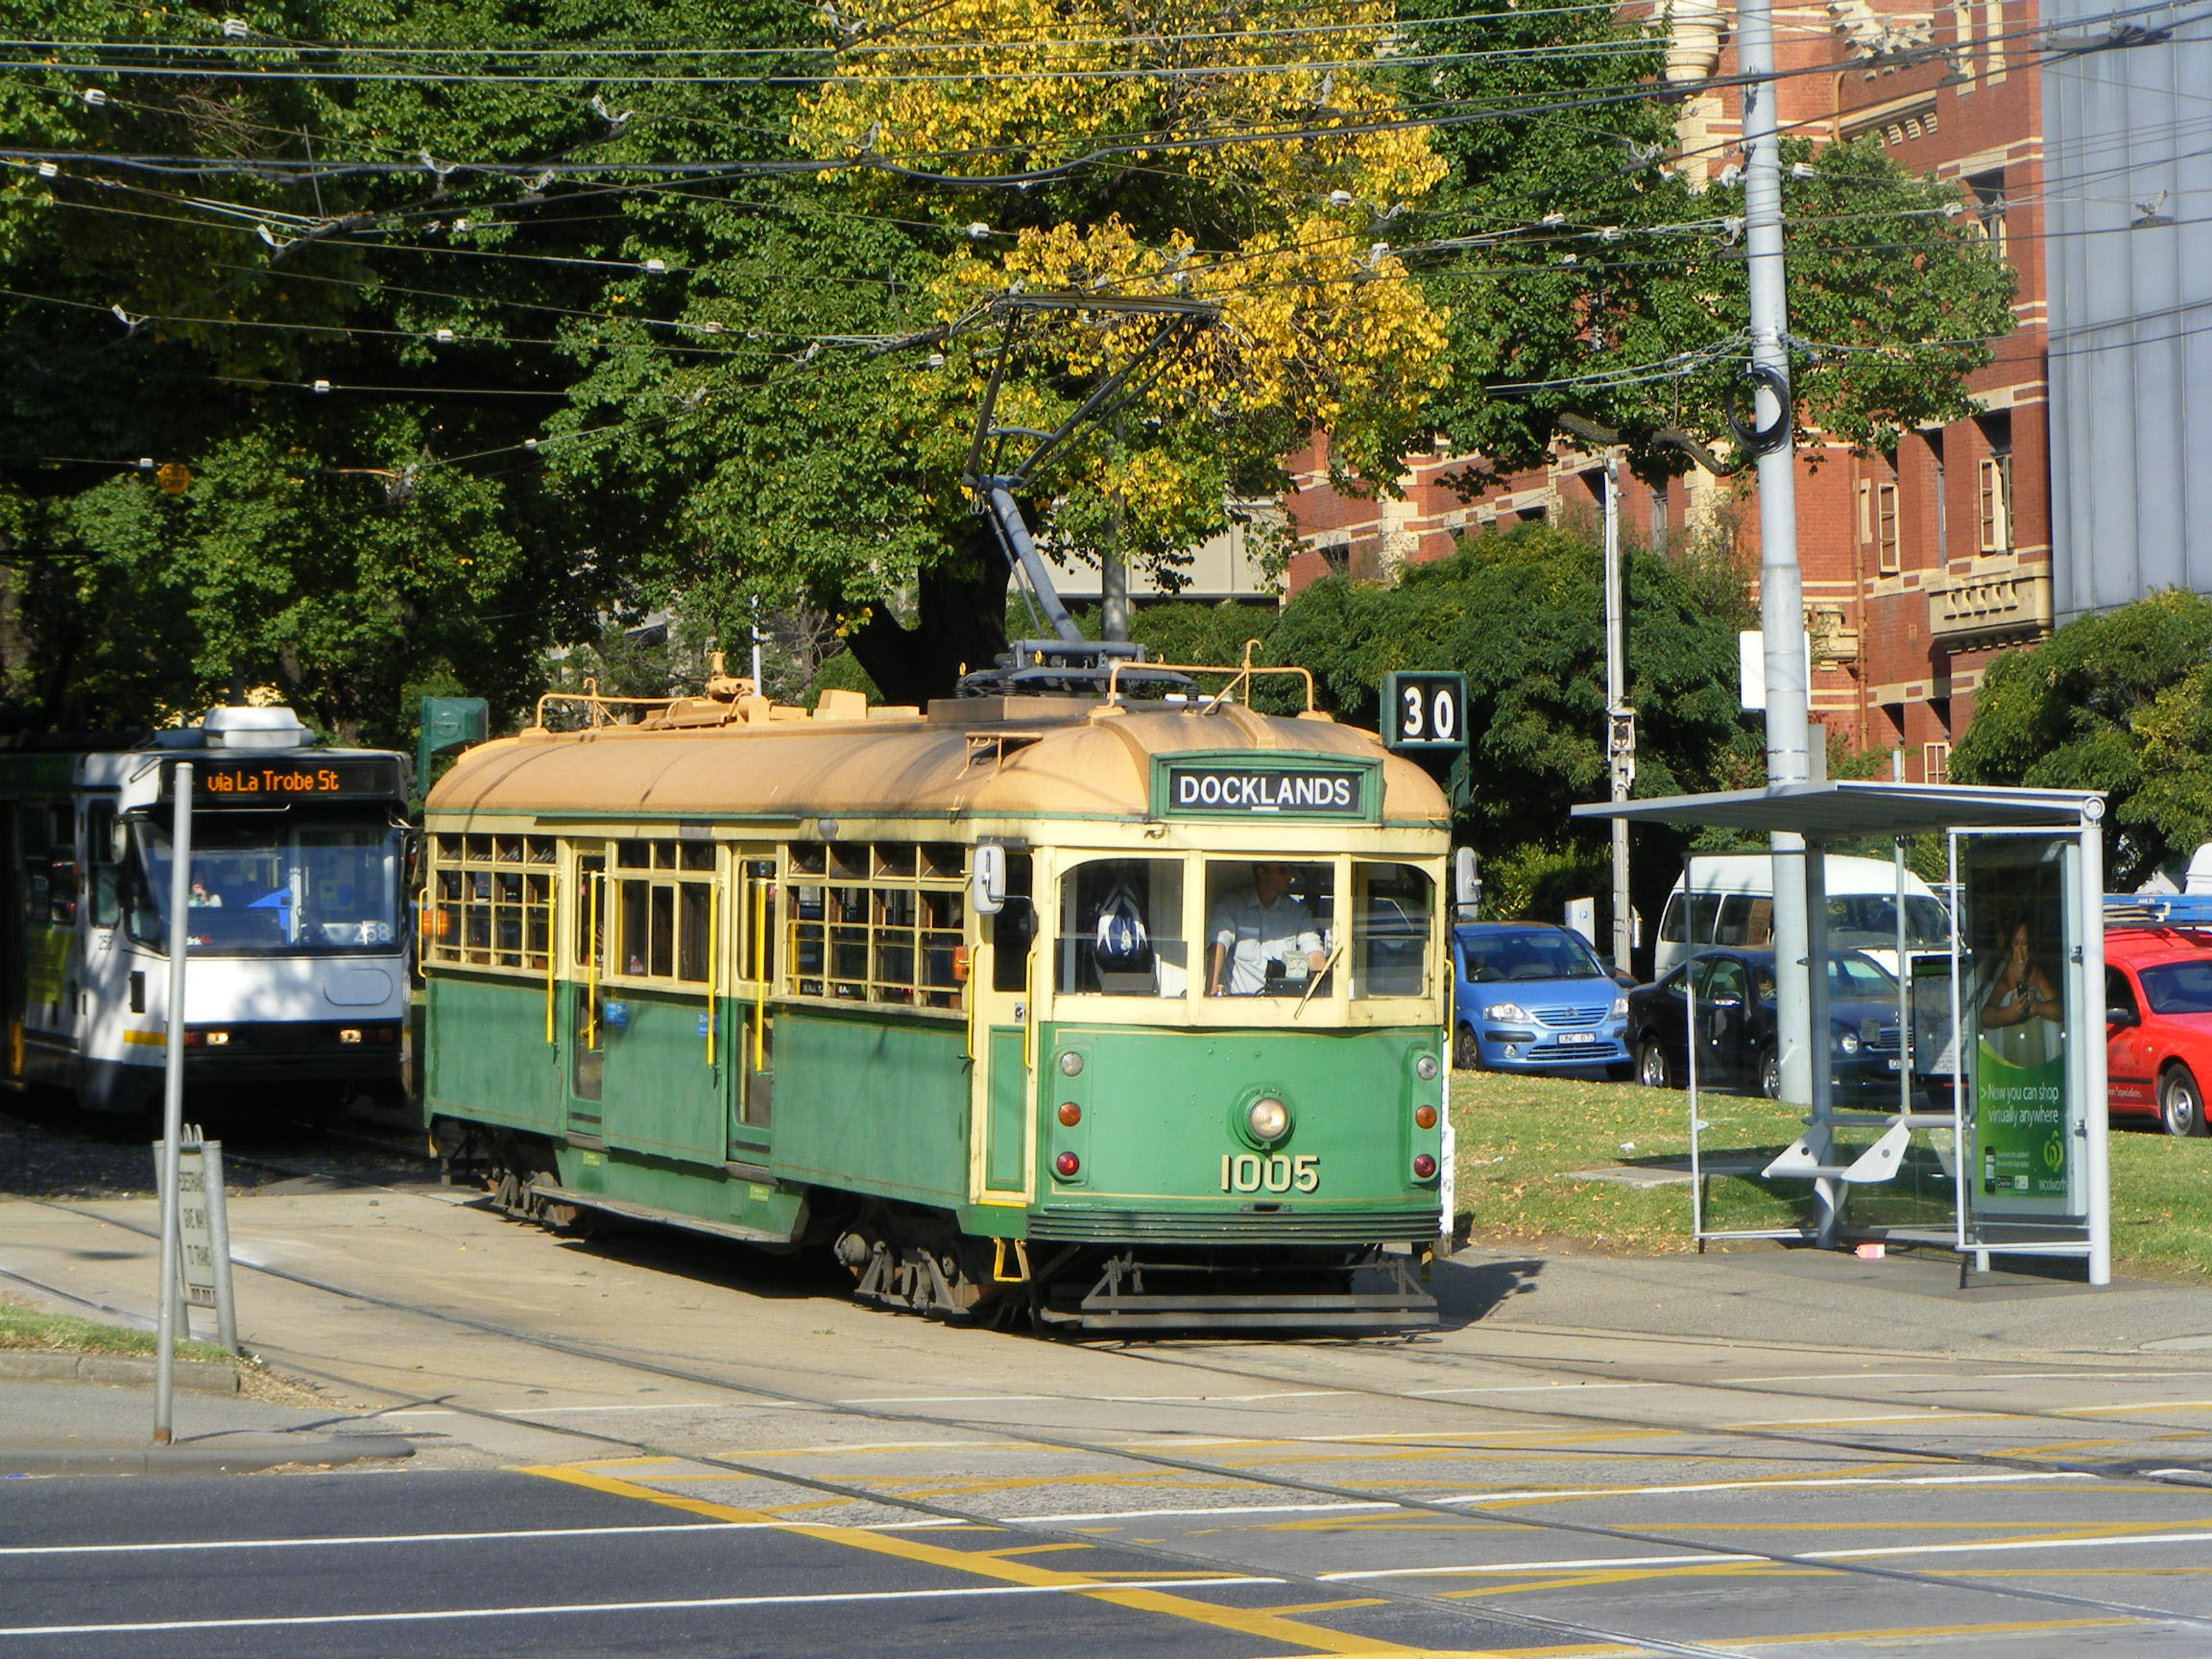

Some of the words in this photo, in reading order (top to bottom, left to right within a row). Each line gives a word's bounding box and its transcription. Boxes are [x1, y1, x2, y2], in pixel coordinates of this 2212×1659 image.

[1404, 685, 1455, 738] 30
[207, 772, 233, 792] via
[237, 770, 259, 792] La
[262, 770, 314, 792] Trobe
[318, 769, 340, 791] St
[1179, 776, 1351, 806] DOCKLANDS
[1987, 1083, 2006, 1101] Now
[2007, 1087, 2022, 1104] you
[2023, 1087, 2037, 1100] can
[2038, 1082, 2059, 1105] shop
[1987, 1105, 2018, 1128] virtually
[2019, 1105, 2059, 1128] anywhere
[1220, 1154, 1321, 1193] 1005
